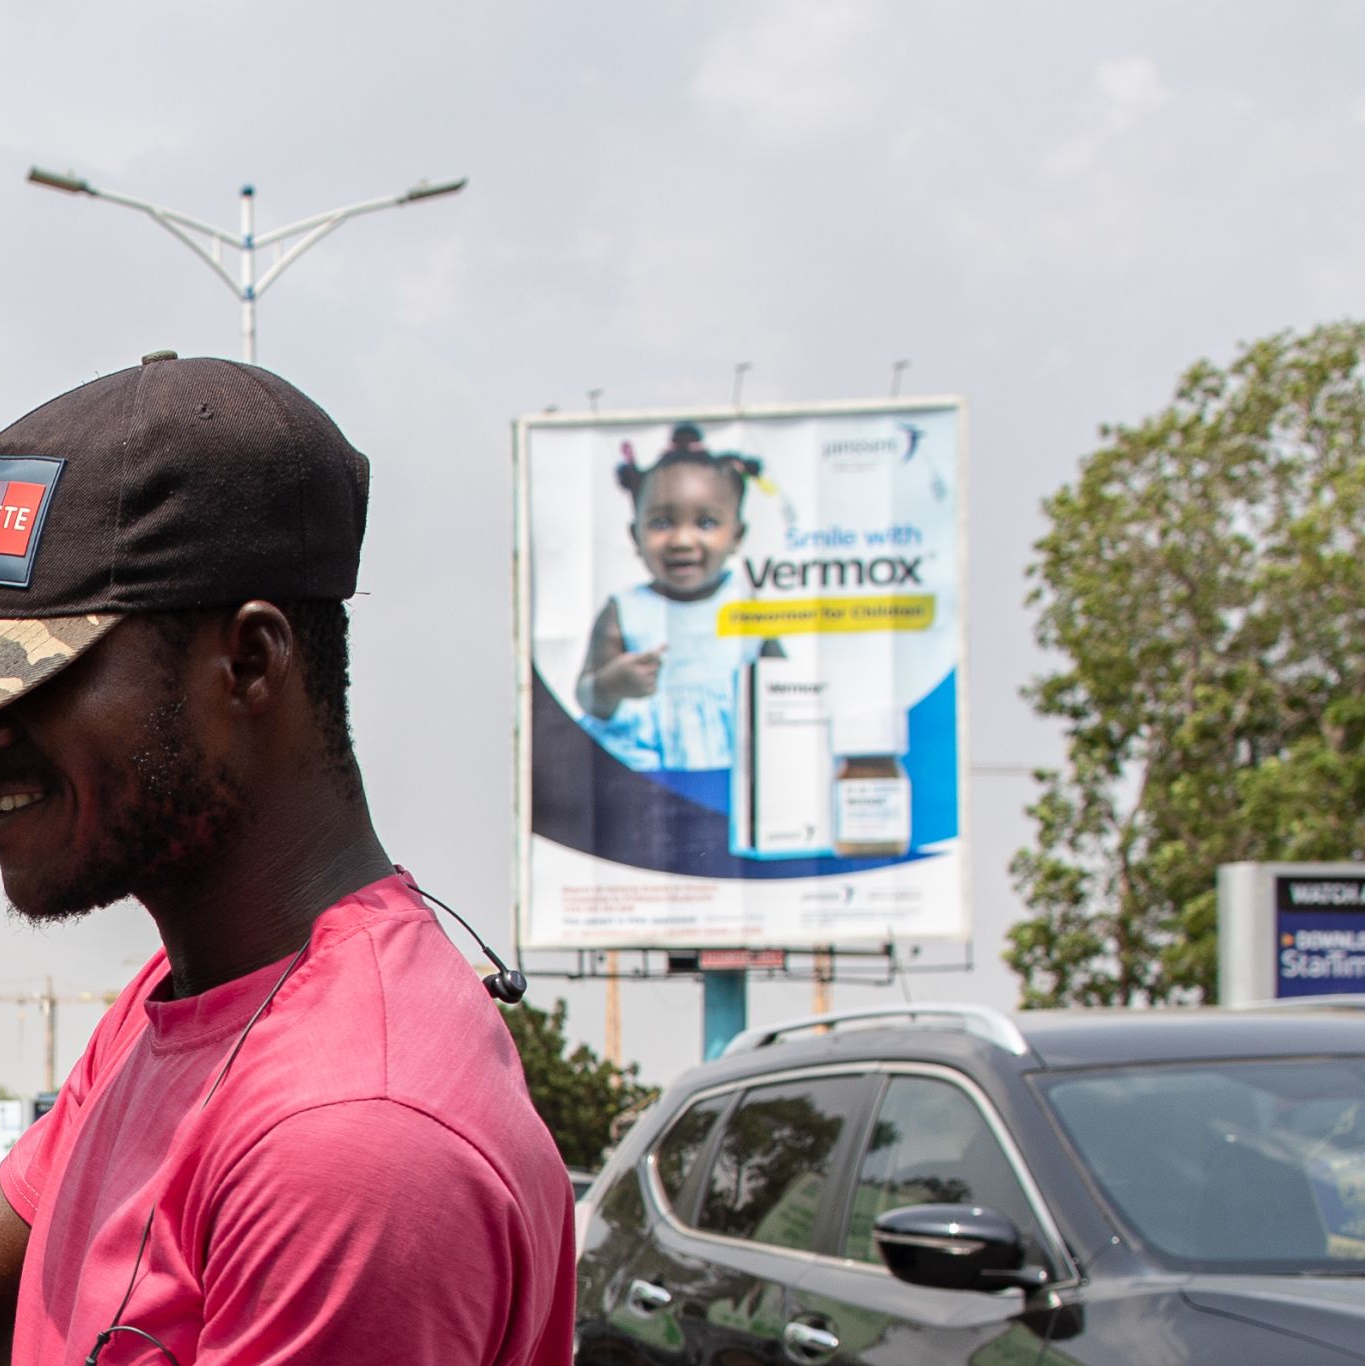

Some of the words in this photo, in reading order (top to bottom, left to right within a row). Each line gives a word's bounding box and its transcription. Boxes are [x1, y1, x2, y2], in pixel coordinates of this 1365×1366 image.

[784, 524, 858, 551] Smile
[864, 525, 923, 548] with
[744, 556, 924, 592] Vermox
